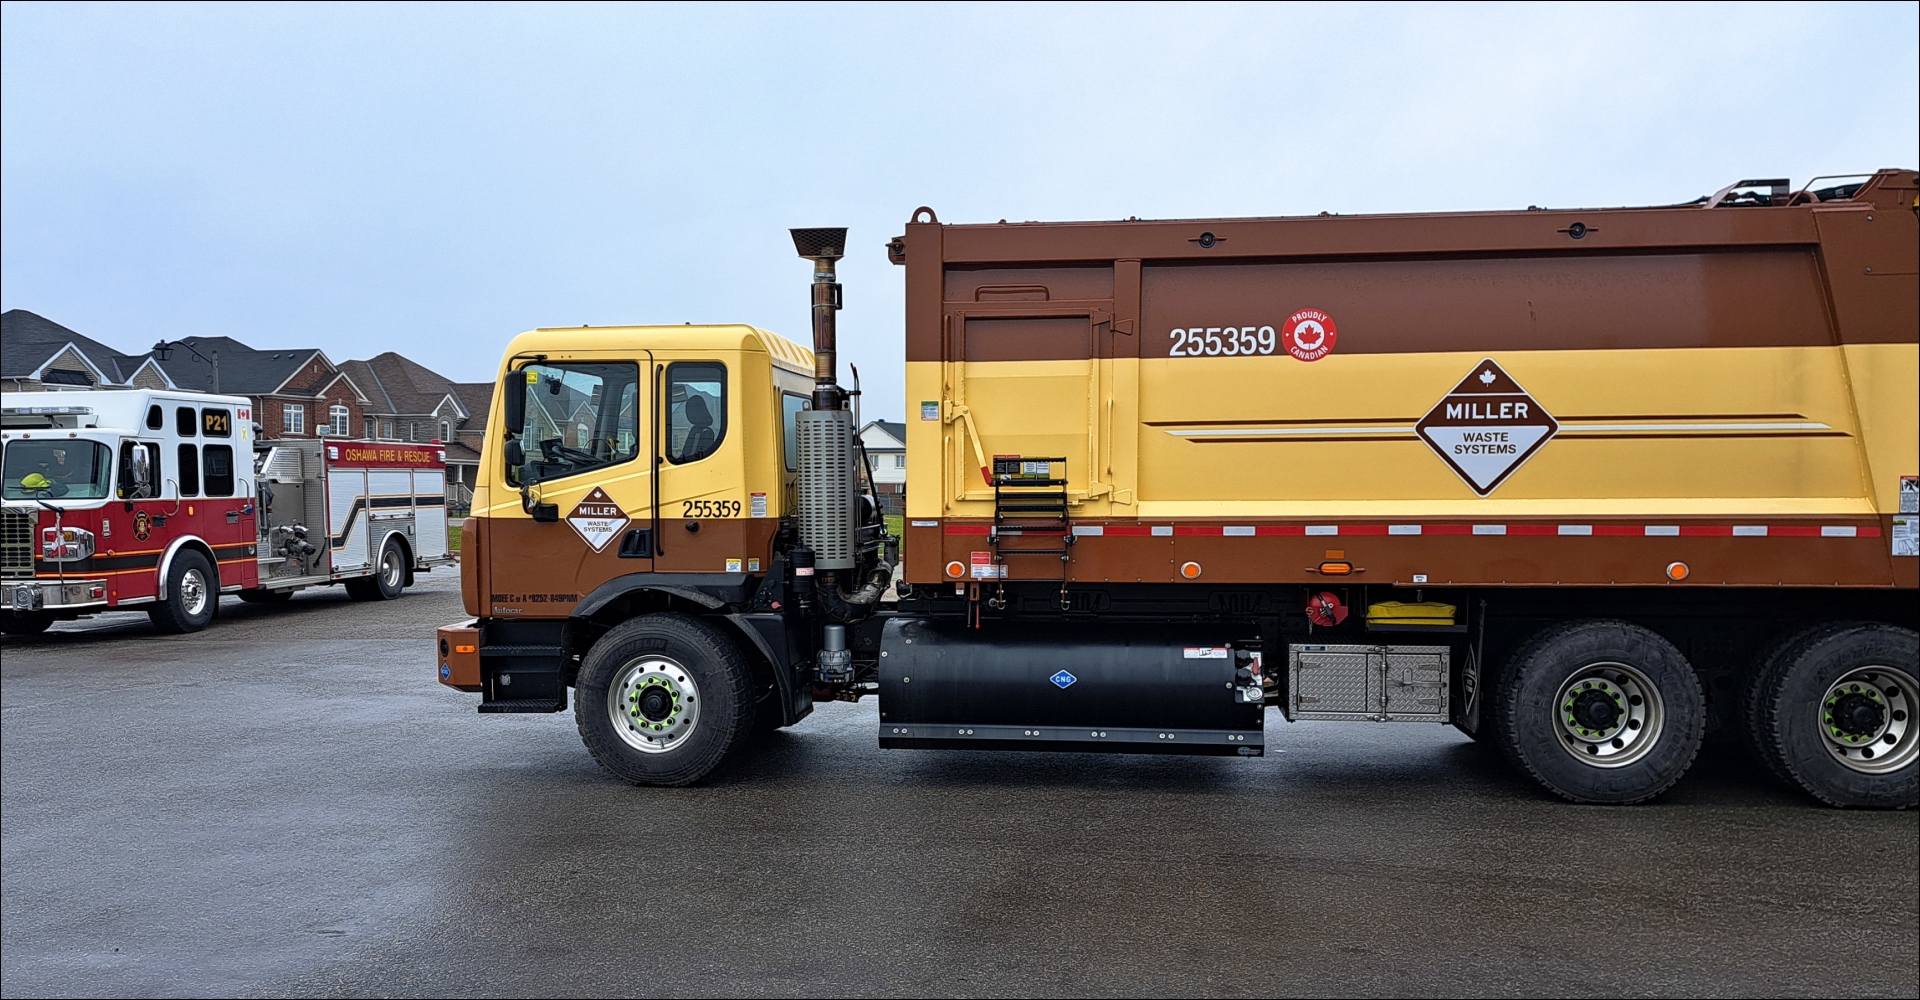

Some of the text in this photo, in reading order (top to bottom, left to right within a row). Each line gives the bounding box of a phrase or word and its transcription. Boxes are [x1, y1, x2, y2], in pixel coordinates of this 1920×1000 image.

[1291, 311, 1328, 324] PROUDLY
[1169, 325, 1276, 357] 255359
[1290, 345, 1329, 361] CANADIAN
[1446, 402, 1529, 420] MILLER
[206, 415, 227, 431] P21
[1463, 432, 1509, 442] WASTE
[345, 448, 431, 463] OSHAWA FIRE & RESCUE
[1454, 444, 1517, 455] SYSTEMS
[579, 506, 617, 516] MILLER
[682, 500, 741, 518] 255359
[510, 594, 515, 602] C
[522, 594, 527, 602] A
[493, 606, 522, 614] Autocar
[605, 638, 664, 667] MICHELIN
